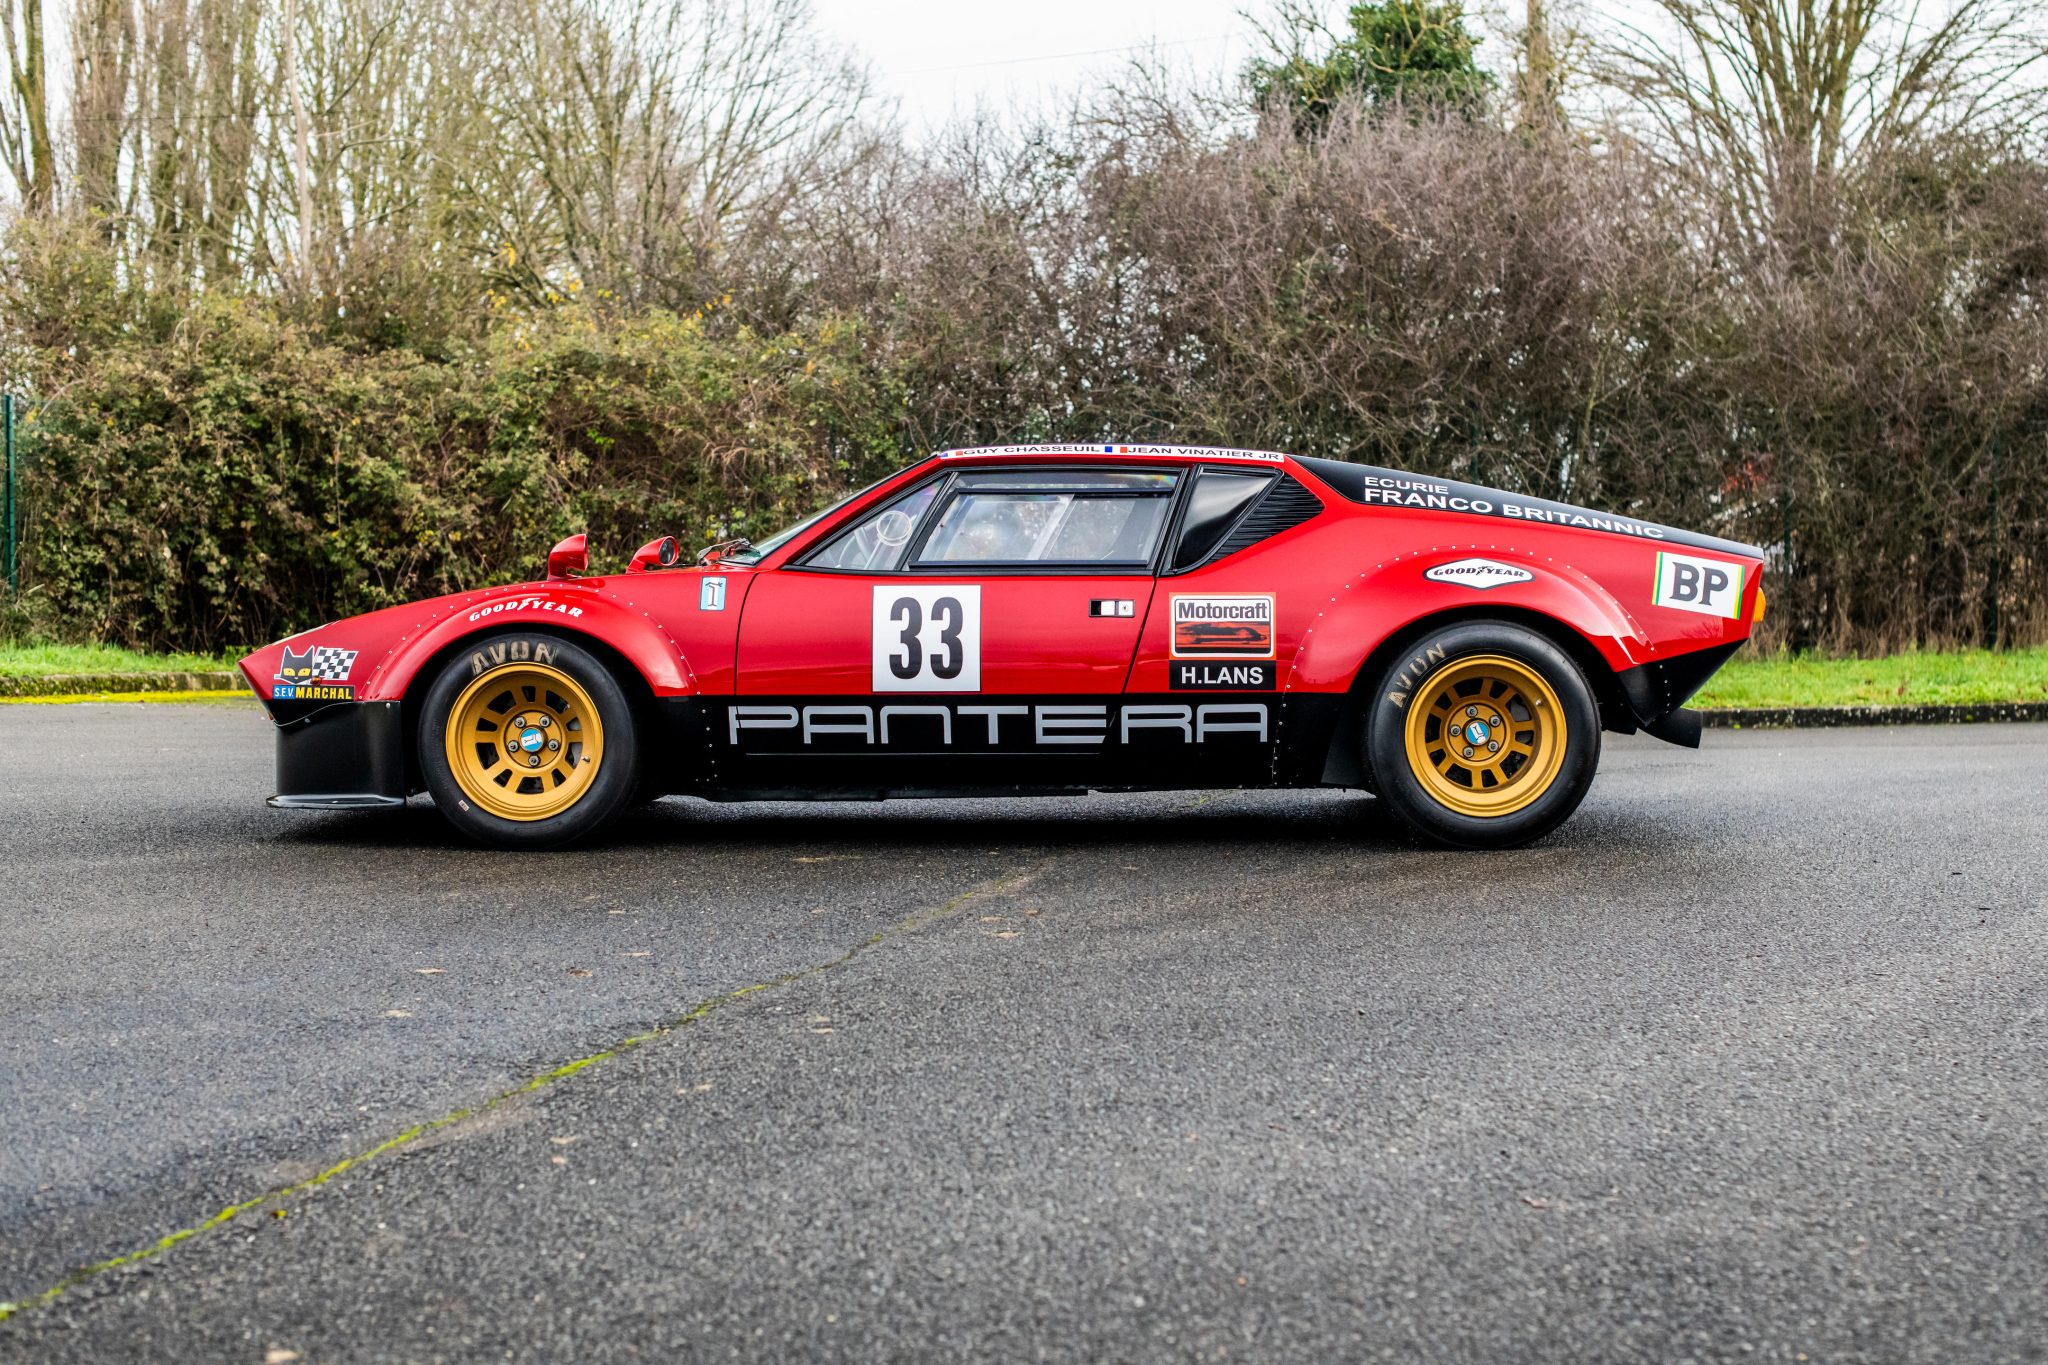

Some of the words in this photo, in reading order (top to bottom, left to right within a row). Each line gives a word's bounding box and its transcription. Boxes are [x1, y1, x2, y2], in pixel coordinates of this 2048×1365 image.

[1004, 445, 1100, 453] CHASSEUIL
[1178, 448, 1253, 458] VINATIER
[1365, 476, 1449, 494] ECURIE
[1365, 488, 1493, 513] FRANCO
[1503, 504, 1664, 538] BRITANNIC
[1433, 566, 1525, 577] GOODYEAR
[1669, 561, 1729, 606] BP
[469, 597, 583, 622] GOODYEAR
[1178, 602, 1267, 619] Motorcraft
[889, 596, 963, 680] 33
[471, 640, 557, 675] AVON
[1181, 666, 1263, 685] H.LANS
[1387, 643, 1445, 708] AVON
[296, 686, 352, 699] MARCHAL
[728, 704, 1268, 745] PANTERA
